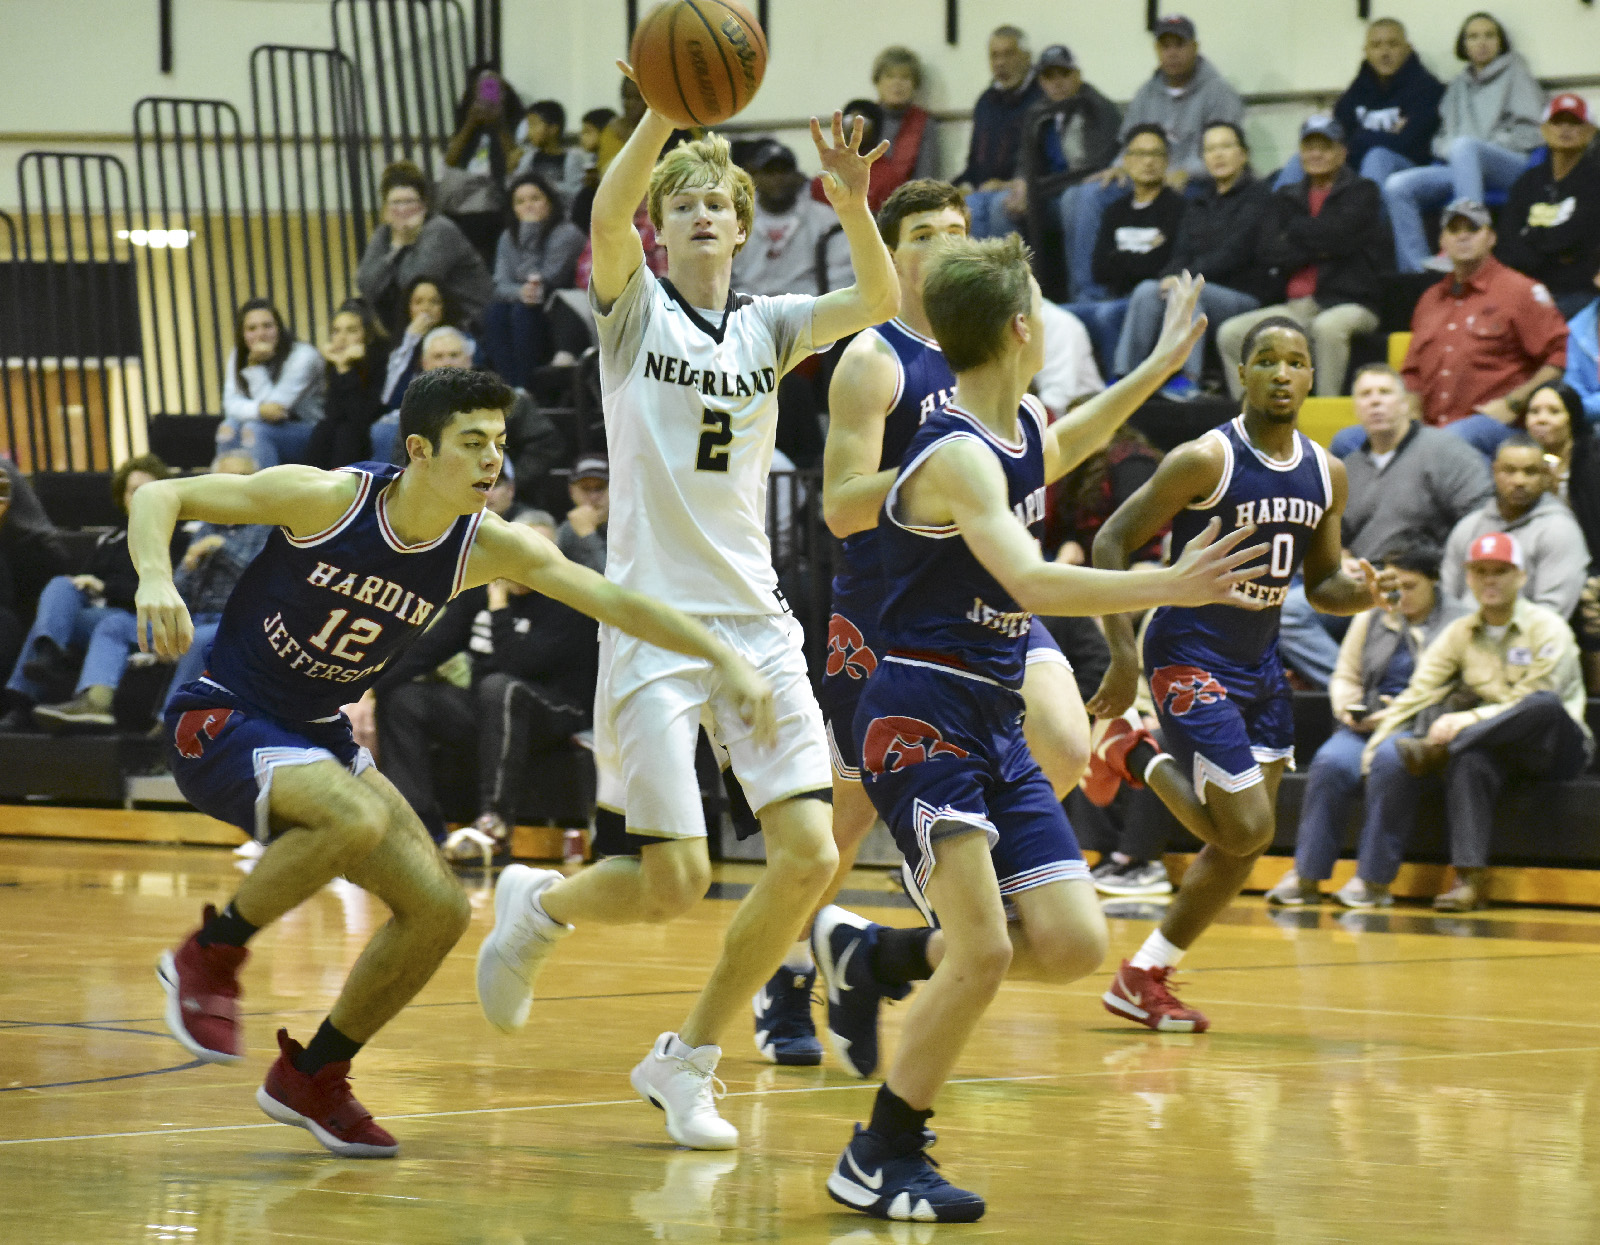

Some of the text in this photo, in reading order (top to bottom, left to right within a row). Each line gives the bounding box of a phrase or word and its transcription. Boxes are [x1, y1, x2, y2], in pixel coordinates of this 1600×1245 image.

[643, 351, 775, 397] NEDERLAND
[695, 407, 733, 474] 2
[1271, 533, 1294, 578] 0
[307, 561, 434, 626] HARDIN
[308, 608, 383, 662] 12
